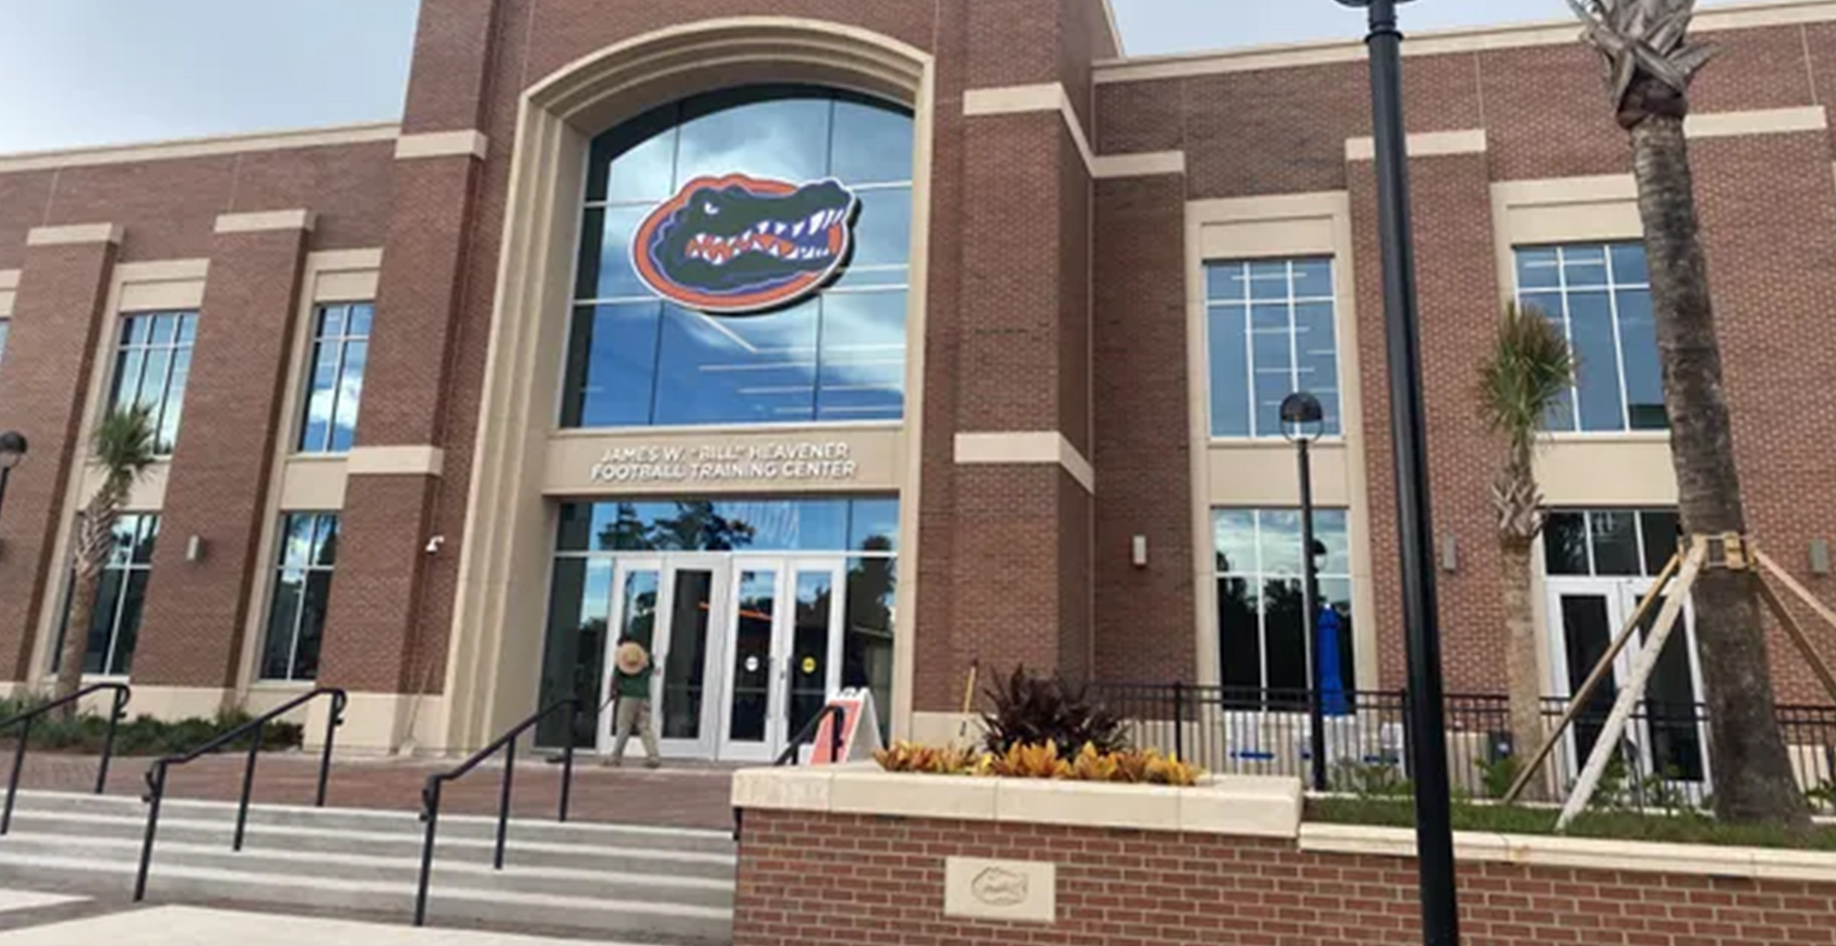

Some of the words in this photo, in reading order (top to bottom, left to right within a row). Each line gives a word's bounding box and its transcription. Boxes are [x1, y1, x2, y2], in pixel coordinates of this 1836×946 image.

[602, 446, 658, 462] JAMES
[662, 446, 686, 462] W.
[750, 442, 848, 460] HEAVENER
[591, 463, 686, 481] FOOTBALL
[689, 462, 777, 479] TRAINING
[782, 460, 856, 477] CENTER
